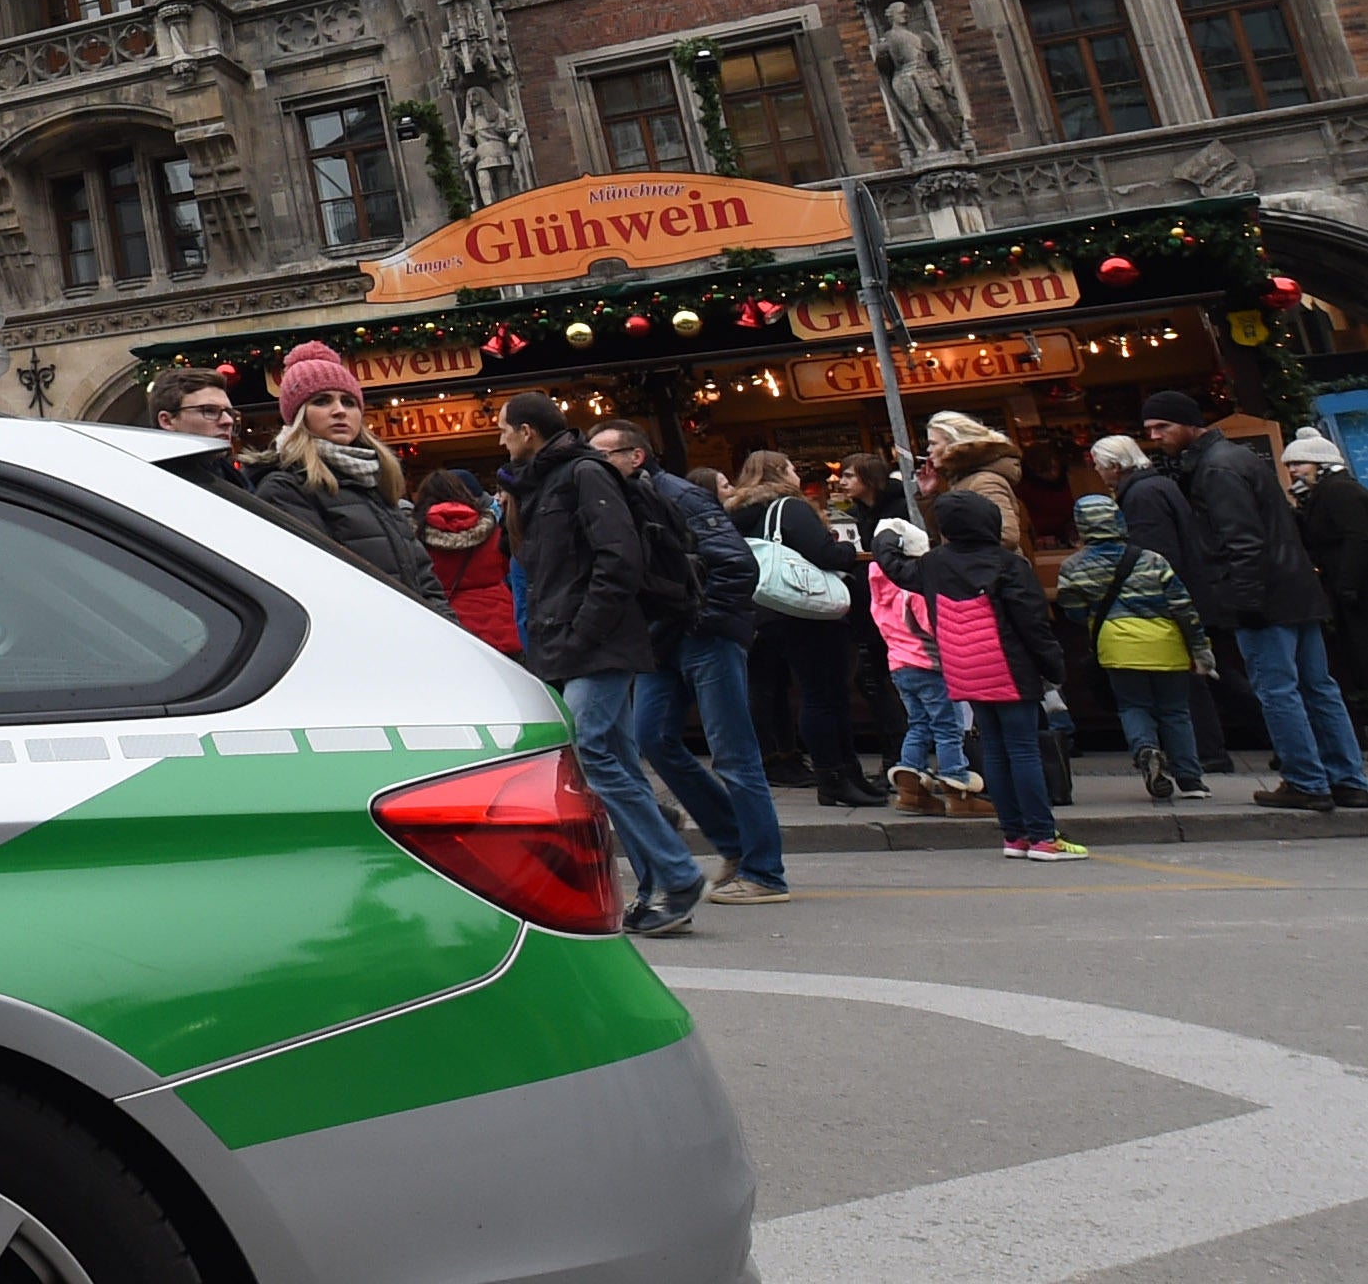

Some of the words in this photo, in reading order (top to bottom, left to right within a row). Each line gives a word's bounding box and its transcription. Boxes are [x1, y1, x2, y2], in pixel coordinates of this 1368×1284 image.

[589, 183, 685, 204] Münchner
[465, 190, 753, 265] Glühwein
[405, 256, 463, 275] Lange's
[796, 269, 1070, 332] Glhwein
[271, 346, 475, 386] hwein
